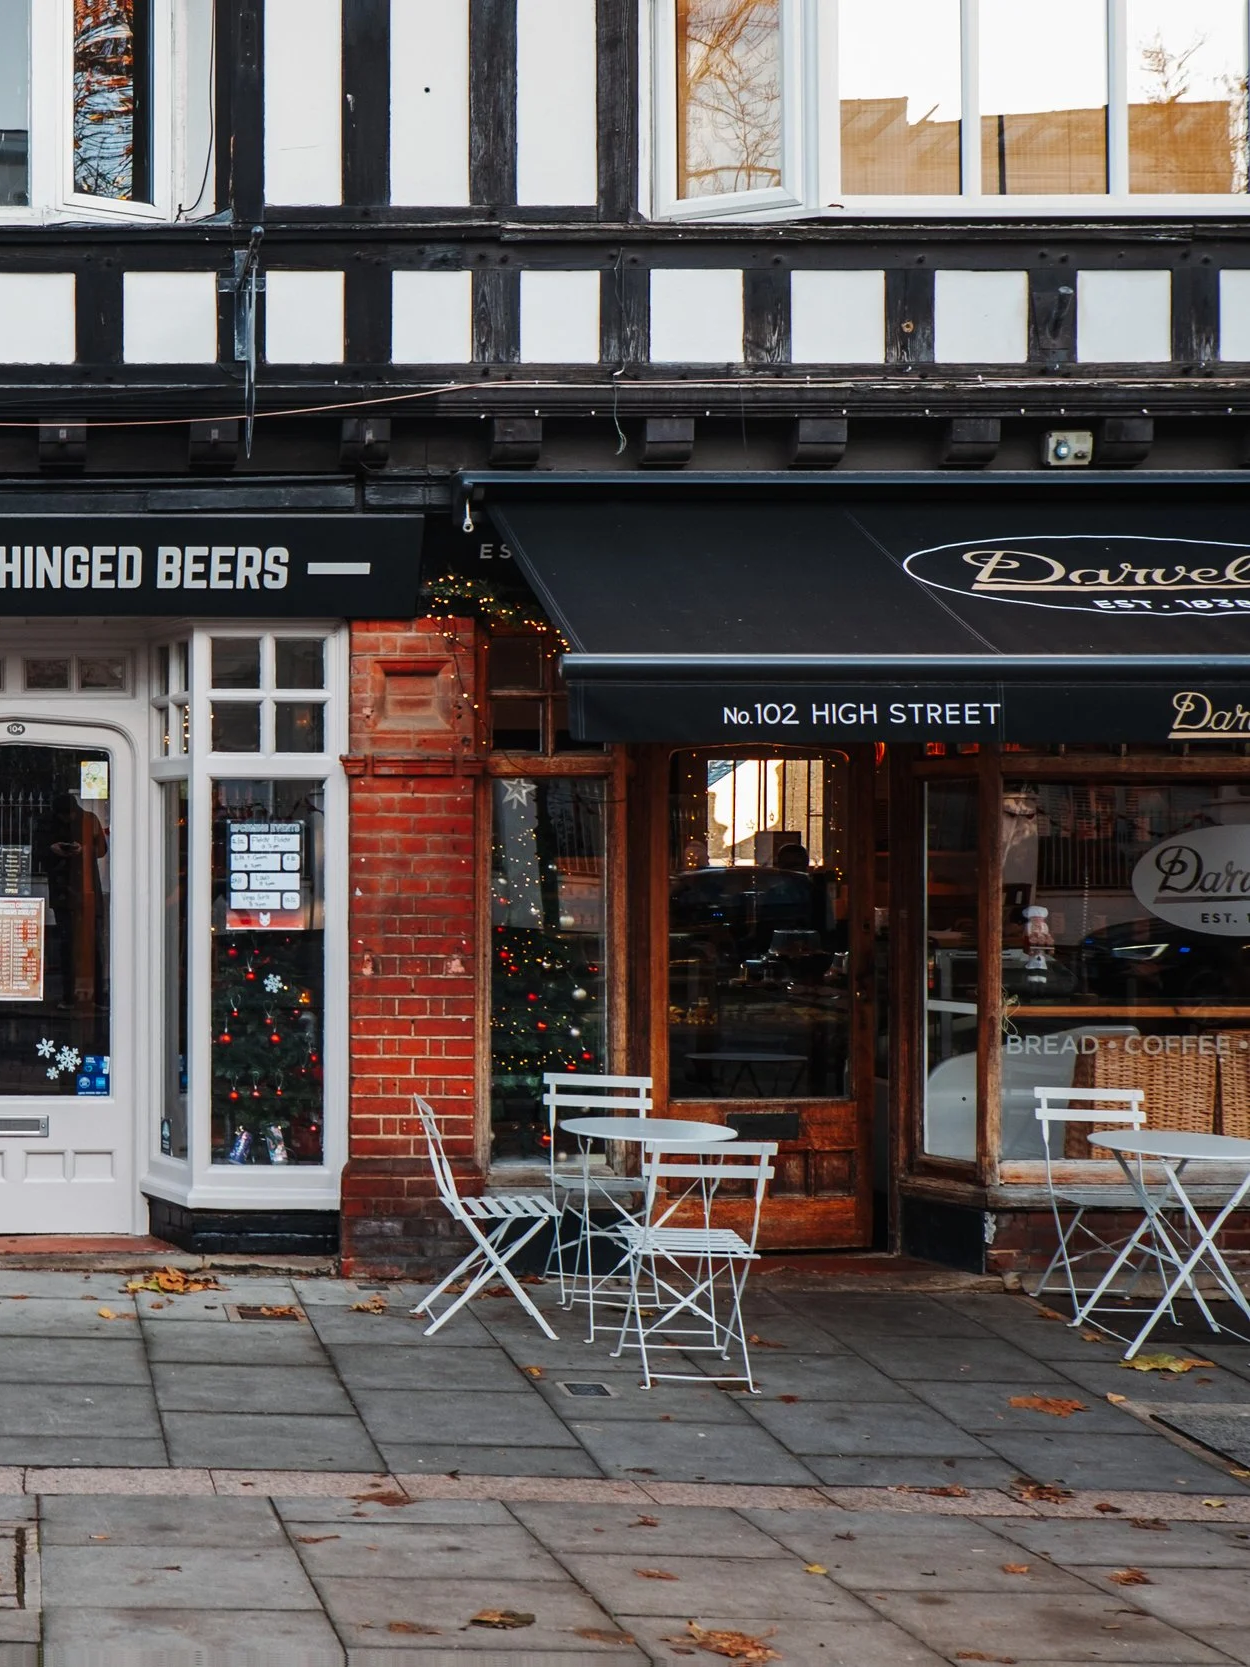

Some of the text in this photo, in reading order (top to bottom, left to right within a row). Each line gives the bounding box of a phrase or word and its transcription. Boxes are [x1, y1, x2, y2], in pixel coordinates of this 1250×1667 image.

[156, 546, 290, 589] BEERS
[811, 703, 878, 725] HIGH
[889, 703, 1001, 725] STREET
[1172, 691, 1250, 731] Dar
[8, 725, 23, 733] 104
[1005, 1034, 1232, 1055] BREAD COFFEE
